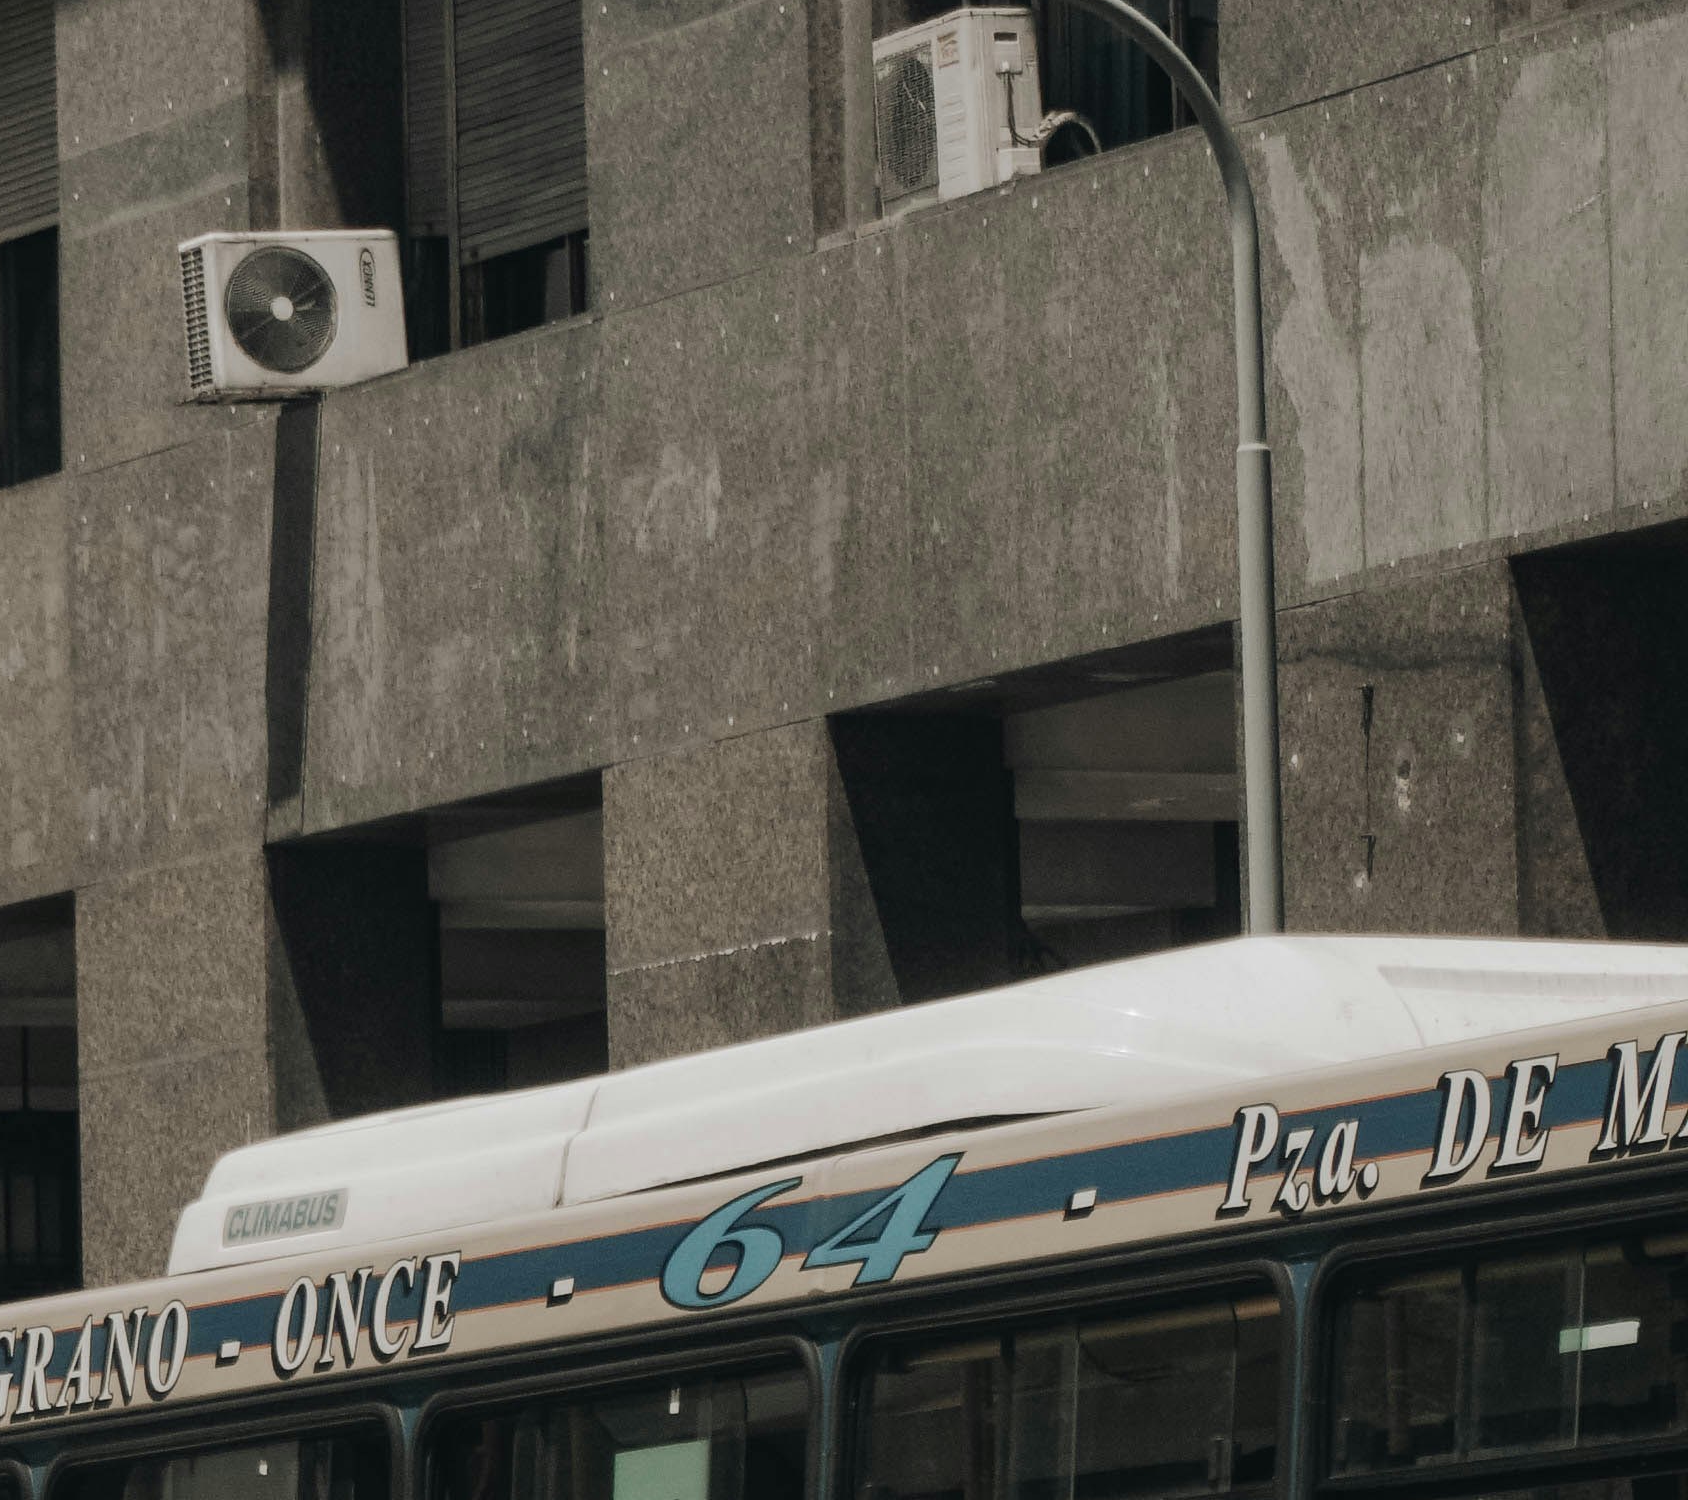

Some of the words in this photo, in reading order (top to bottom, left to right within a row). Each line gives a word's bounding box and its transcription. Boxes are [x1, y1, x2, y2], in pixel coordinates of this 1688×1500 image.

[227, 1193, 340, 1240] CLIMABUS
[273, 1250, 462, 1377] ONCE
[659, 1151, 967, 1311] 64
[1217, 1102, 1380, 1215] Pza.
[1422, 1053, 1559, 1182] DE
[1592, 1031, 1688, 1158] M
